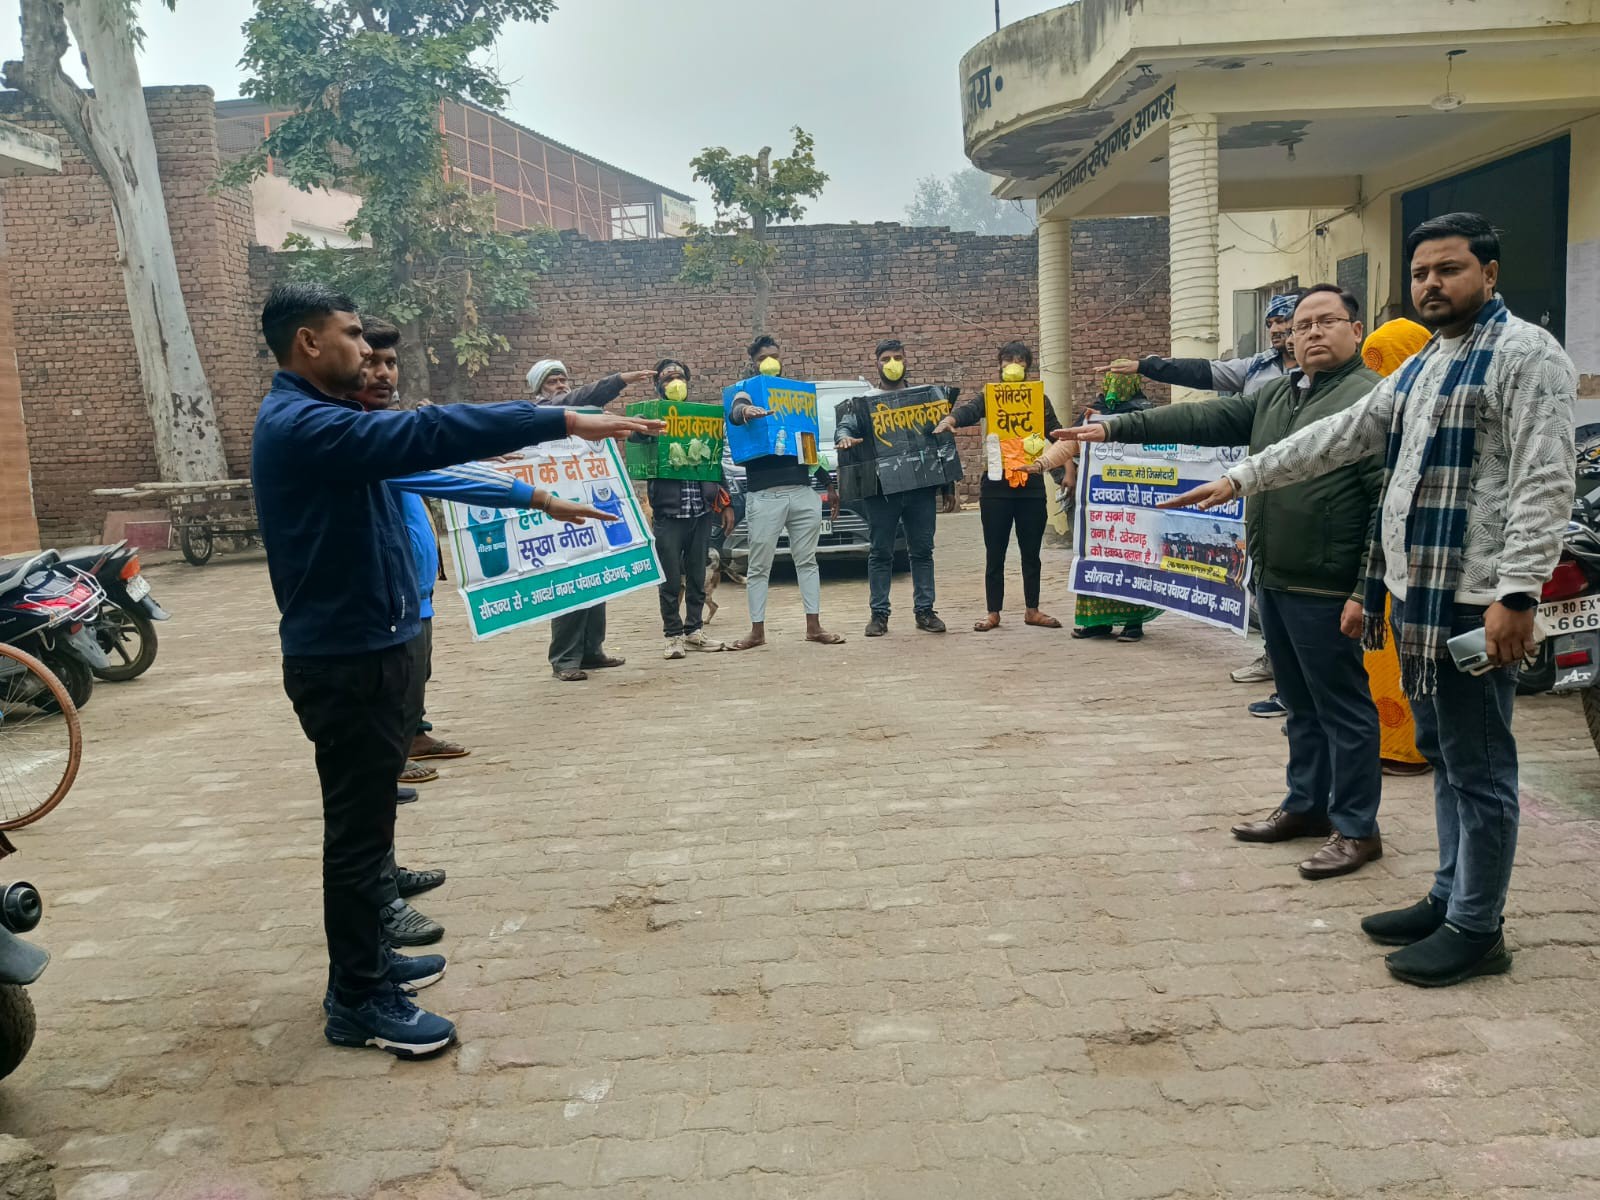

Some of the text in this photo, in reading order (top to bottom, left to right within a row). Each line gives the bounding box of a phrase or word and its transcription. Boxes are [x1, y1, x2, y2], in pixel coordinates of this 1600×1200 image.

[1056, 157, 1087, 199] पंचायत
[1087, 118, 1132, 176] खेरागढ़
[1132, 84, 1176, 139] आगरा
[538, 456, 559, 484] के
[562, 454, 584, 481] दो
[584, 452, 611, 478] रंग
[1140, 486, 1154, 506] एवं
[1089, 510, 1104, 522] हम
[518, 523, 597, 568] सूखा नीला
[1090, 542, 1103, 557] को
[1115, 569, 1124, 587] से
[1132, 574, 1153, 592] आदर्श
[512, 591, 523, 610] से
[531, 580, 555, 605] आदर्श
[555, 583, 576, 597] नगर
[1543, 599, 1596, 617] UP 80 EX
